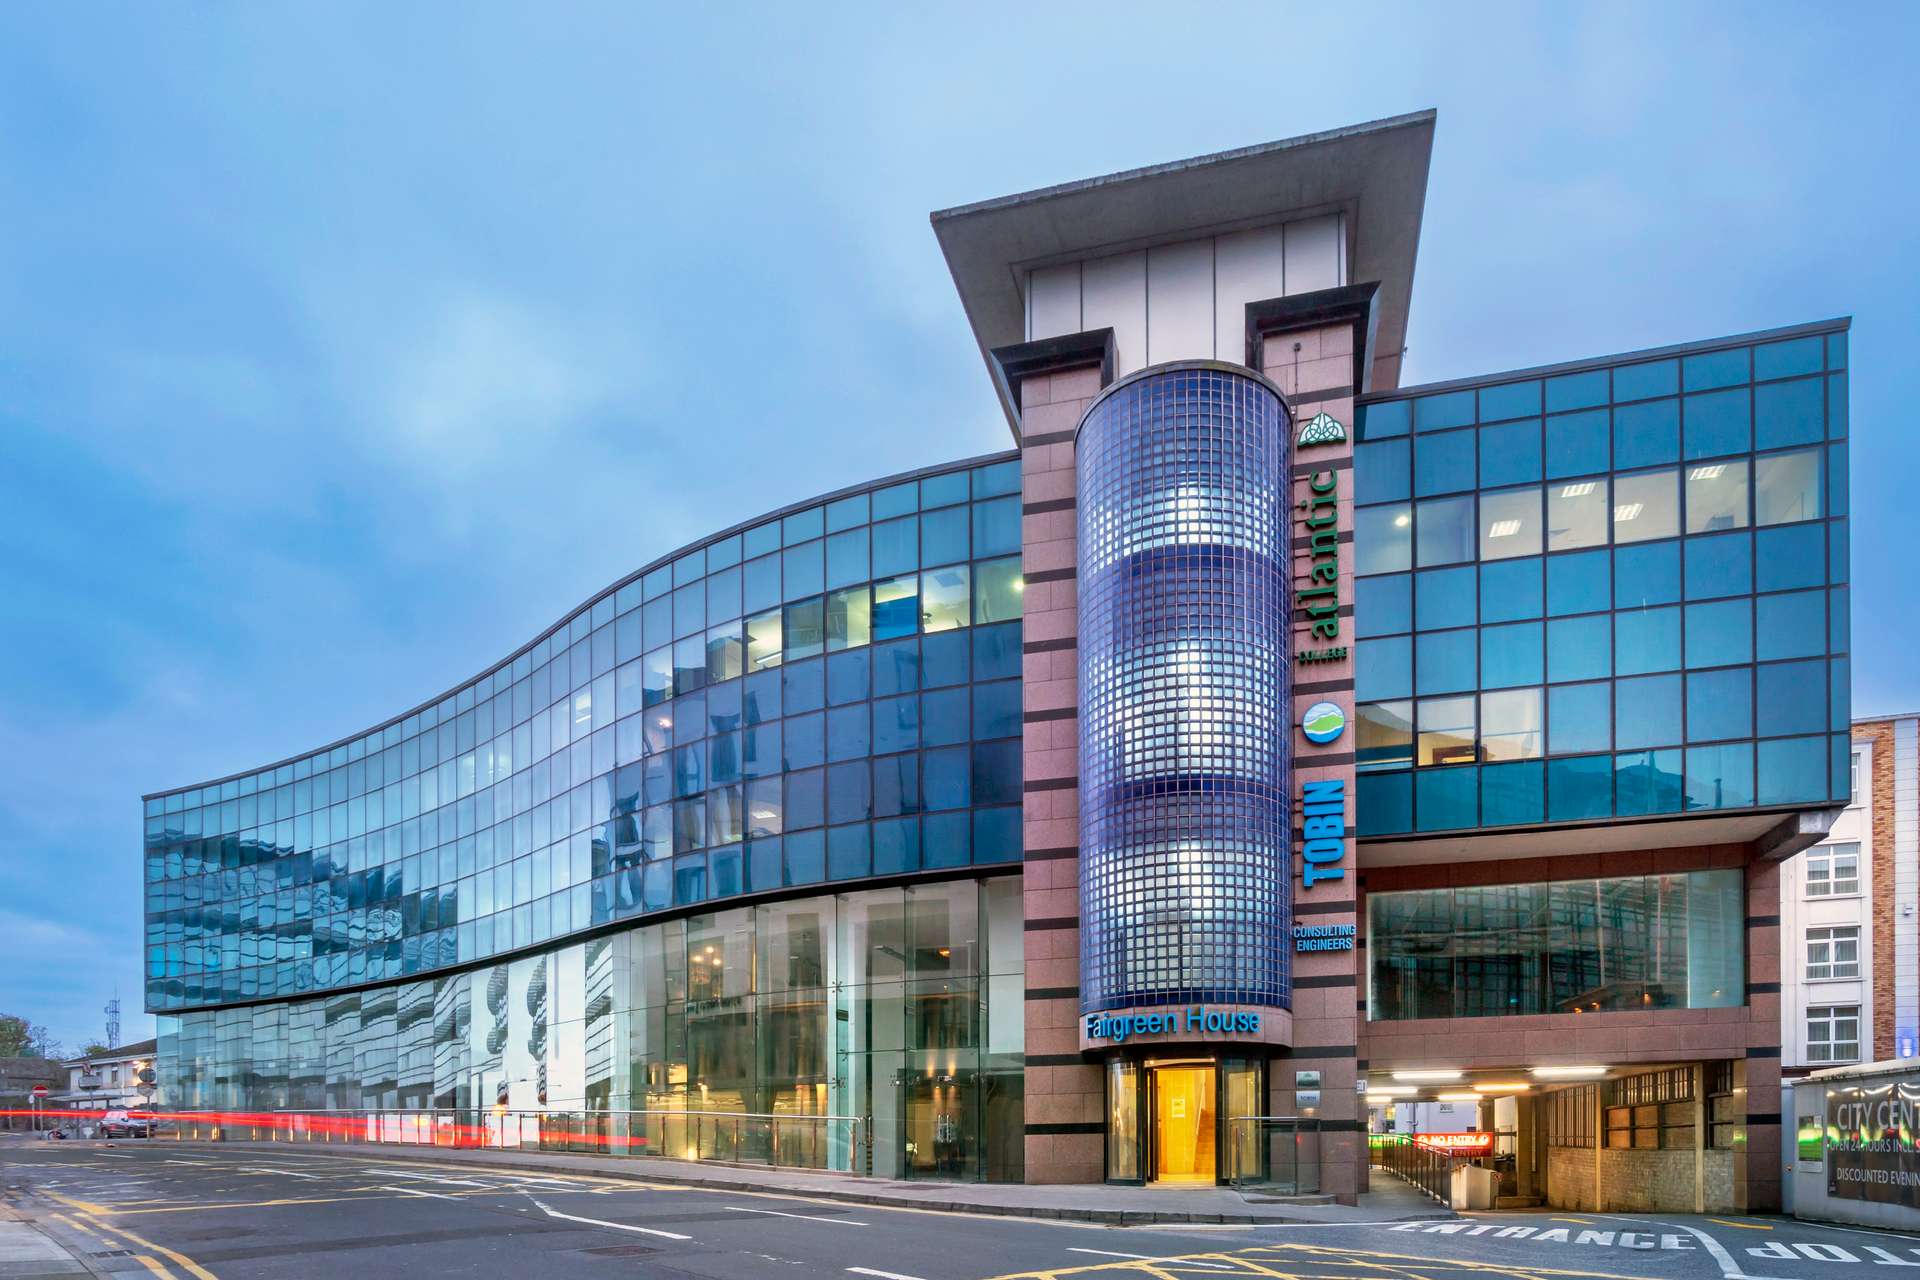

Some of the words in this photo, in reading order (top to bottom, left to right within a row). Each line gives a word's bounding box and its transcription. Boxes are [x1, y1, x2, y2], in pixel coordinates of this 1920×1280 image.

[1299, 467, 1339, 640] atlantic
[1303, 780, 1345, 888] TOBIN
[1293, 925, 1357, 938] CONSULTING
[1296, 938, 1353, 952] ENGINEERS
[1086, 1011, 1178, 1041] Fairgreen
[1186, 1007, 1261, 1033] House
[1837, 1102, 1873, 1130] CITY
[1876, 1100, 1920, 1131] CEN
[1430, 1135, 1446, 1147] NO
[1447, 1135, 1477, 1146] ENTRY
[1836, 1167, 1889, 1184] DISCOUNTED
[1388, 1221, 1697, 1250] ENTRANCE
[1744, 1241, 1920, 1267] TOP
